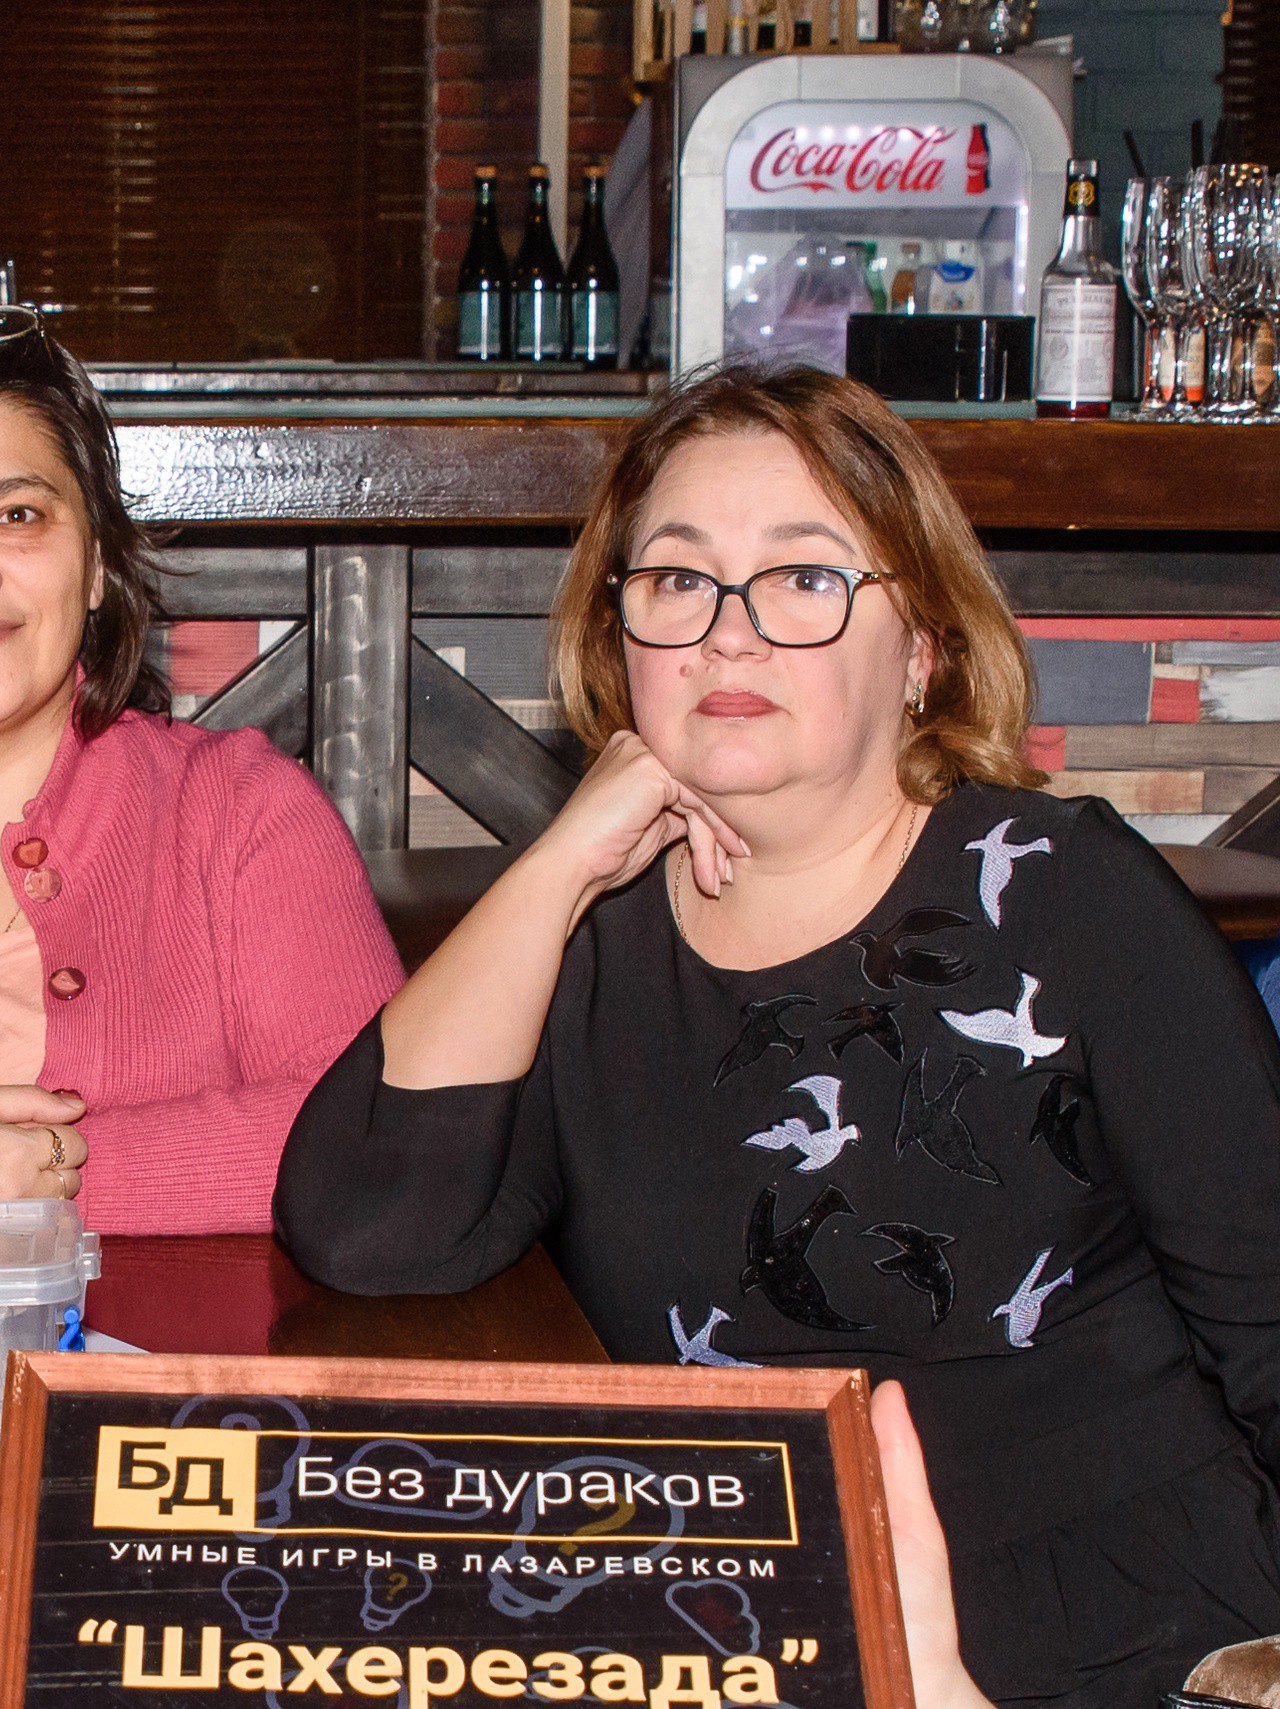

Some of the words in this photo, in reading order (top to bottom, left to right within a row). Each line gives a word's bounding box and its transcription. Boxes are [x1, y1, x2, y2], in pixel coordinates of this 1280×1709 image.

[117, 1439, 234, 1517] БД
[298, 1456, 425, 1501] Без
[446, 1468, 745, 1516] дураков
[108, 1541, 257, 1566] УМНЫЕ
[282, 1548, 393, 1568] ИГРЫ
[418, 1552, 439, 1571] В
[462, 1553, 776, 1578] ЛАЗАРЕВСКОМ
